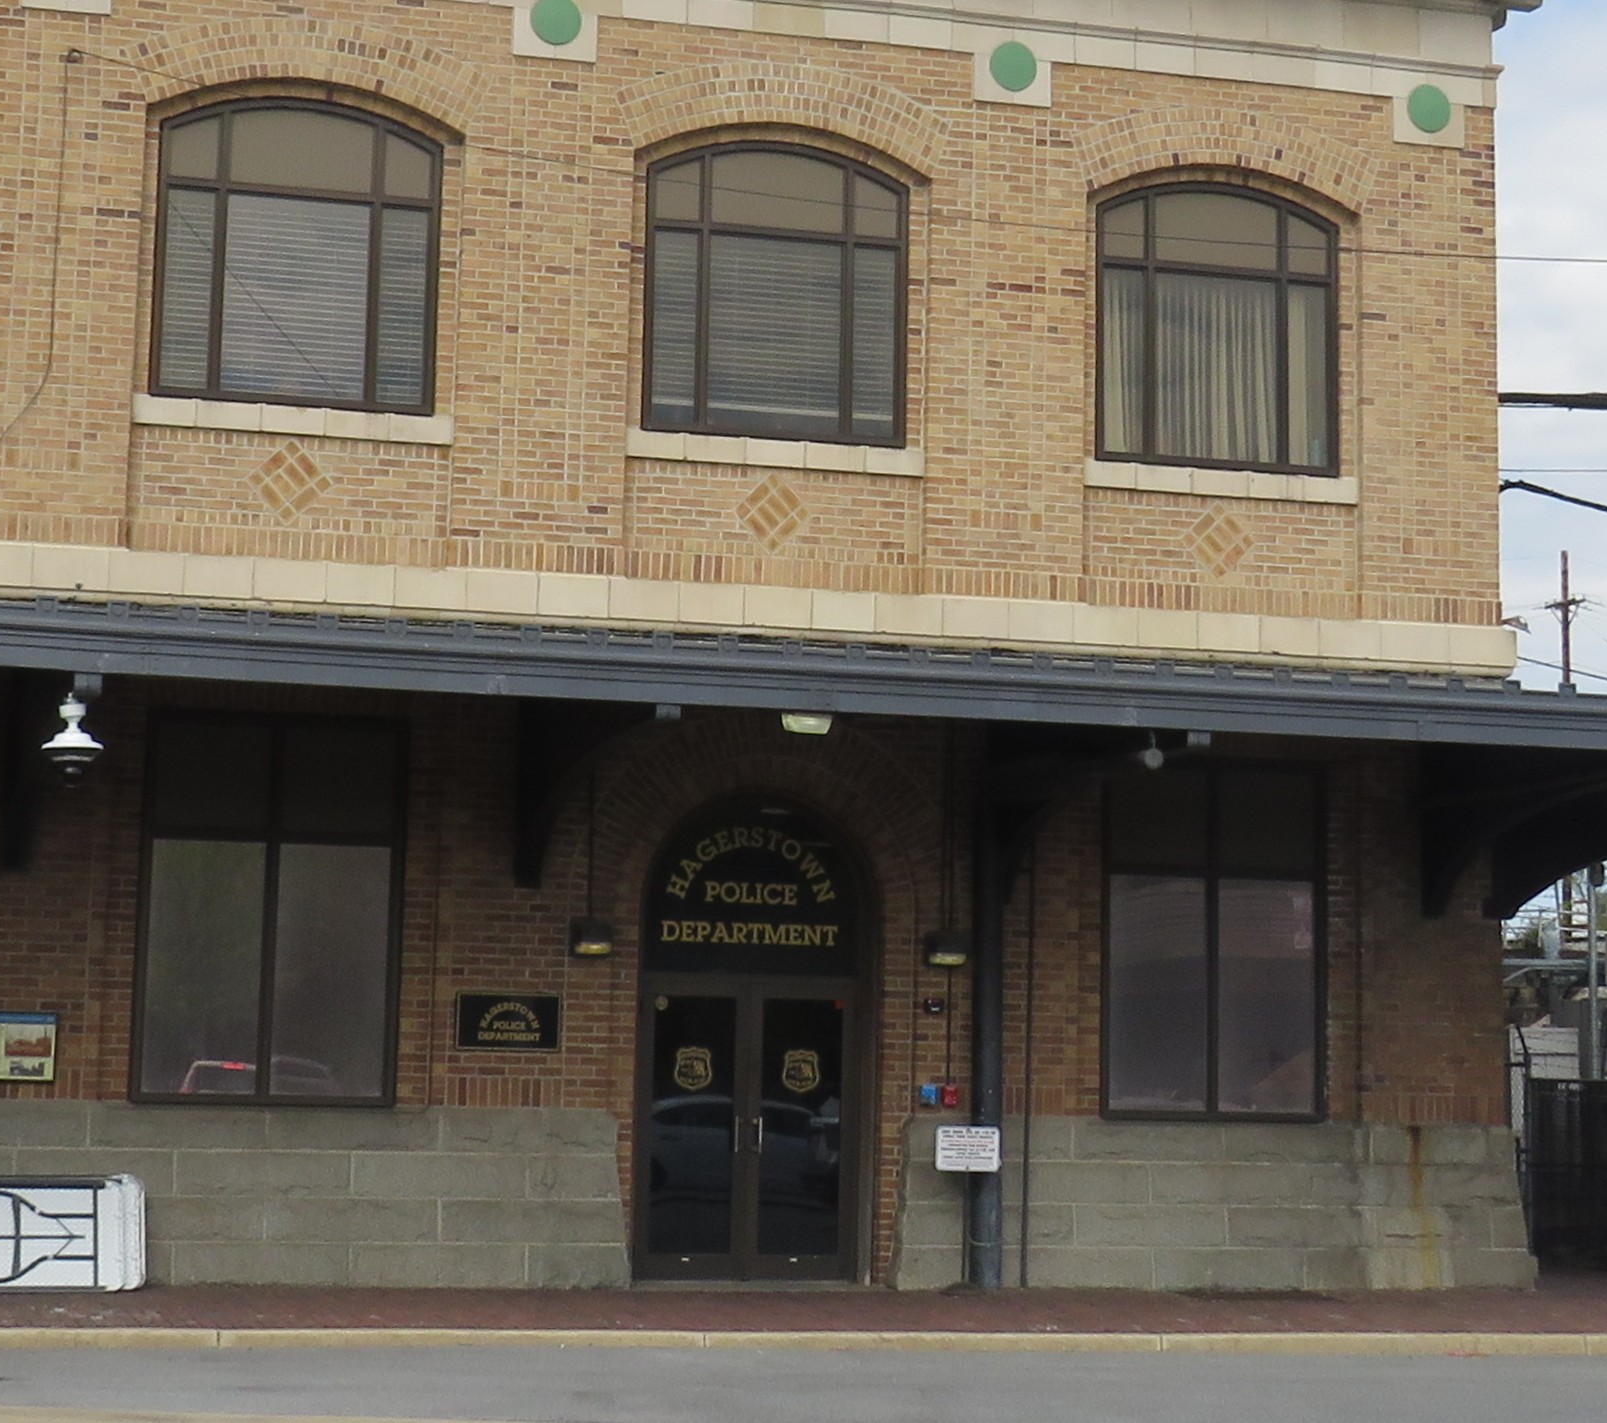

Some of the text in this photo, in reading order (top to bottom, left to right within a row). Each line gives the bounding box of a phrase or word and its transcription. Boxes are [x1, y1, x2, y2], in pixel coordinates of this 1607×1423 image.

[666, 827, 836, 904] HAGERSTOWN
[704, 880, 799, 906] POLICE
[660, 920, 838, 946] DEPARTMENT
[477, 1031, 541, 1042] DEPARTMENT
[493, 1021, 526, 1030] POLICE
